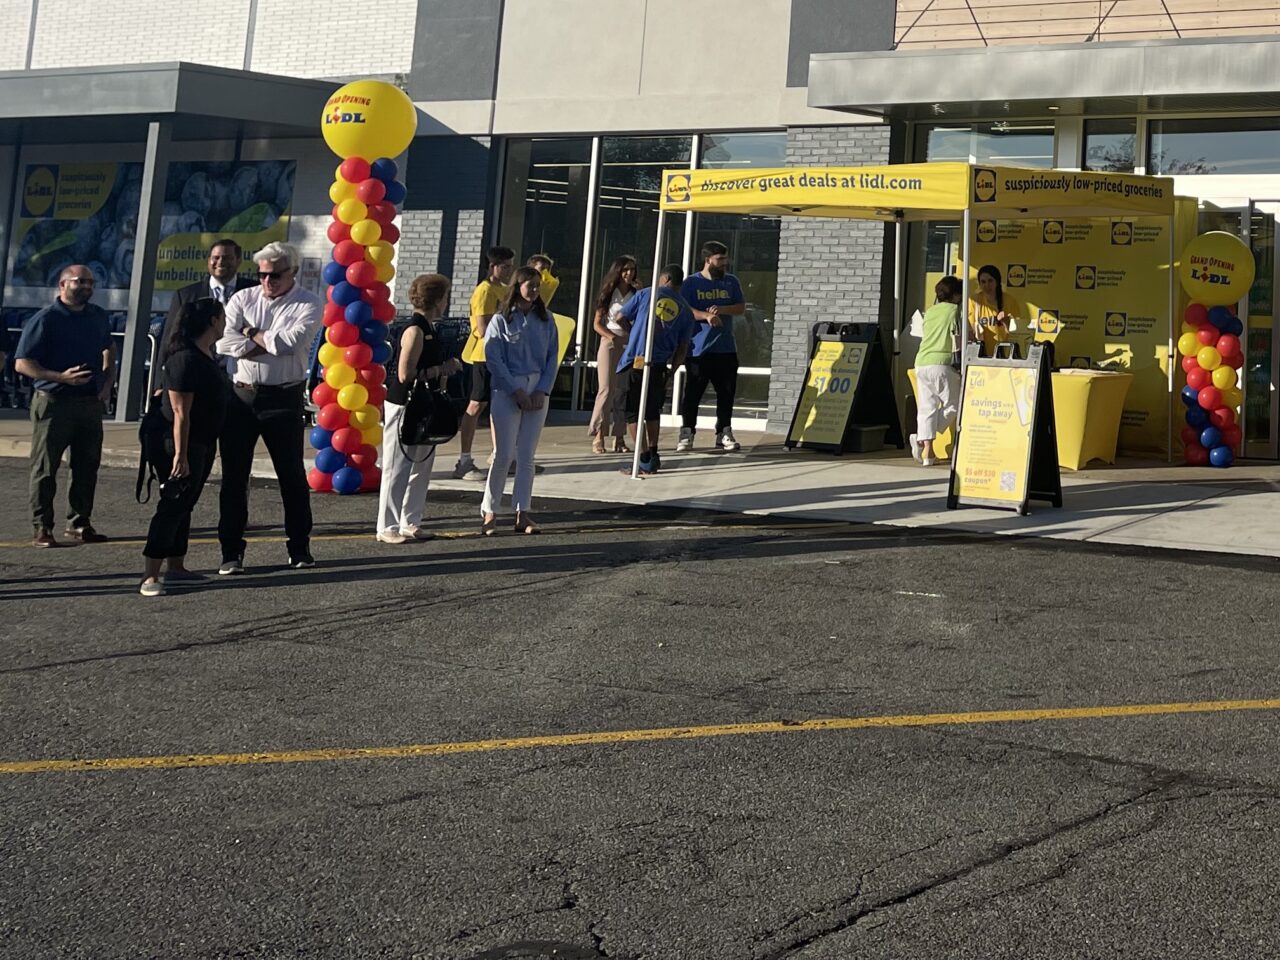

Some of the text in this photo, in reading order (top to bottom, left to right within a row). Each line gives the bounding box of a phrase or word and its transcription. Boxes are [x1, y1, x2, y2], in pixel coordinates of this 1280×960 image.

[700, 172, 922, 192] discover great deals at lidl.com
[1005, 175, 1163, 199] suspiciously low-priced groceries
[158, 246, 208, 260] unbeliev
[1209, 256, 1235, 272] OPENING
[156, 266, 208, 281] unbeliev
[971, 398, 1002, 409] savings
[978, 409, 1012, 420] tap away
